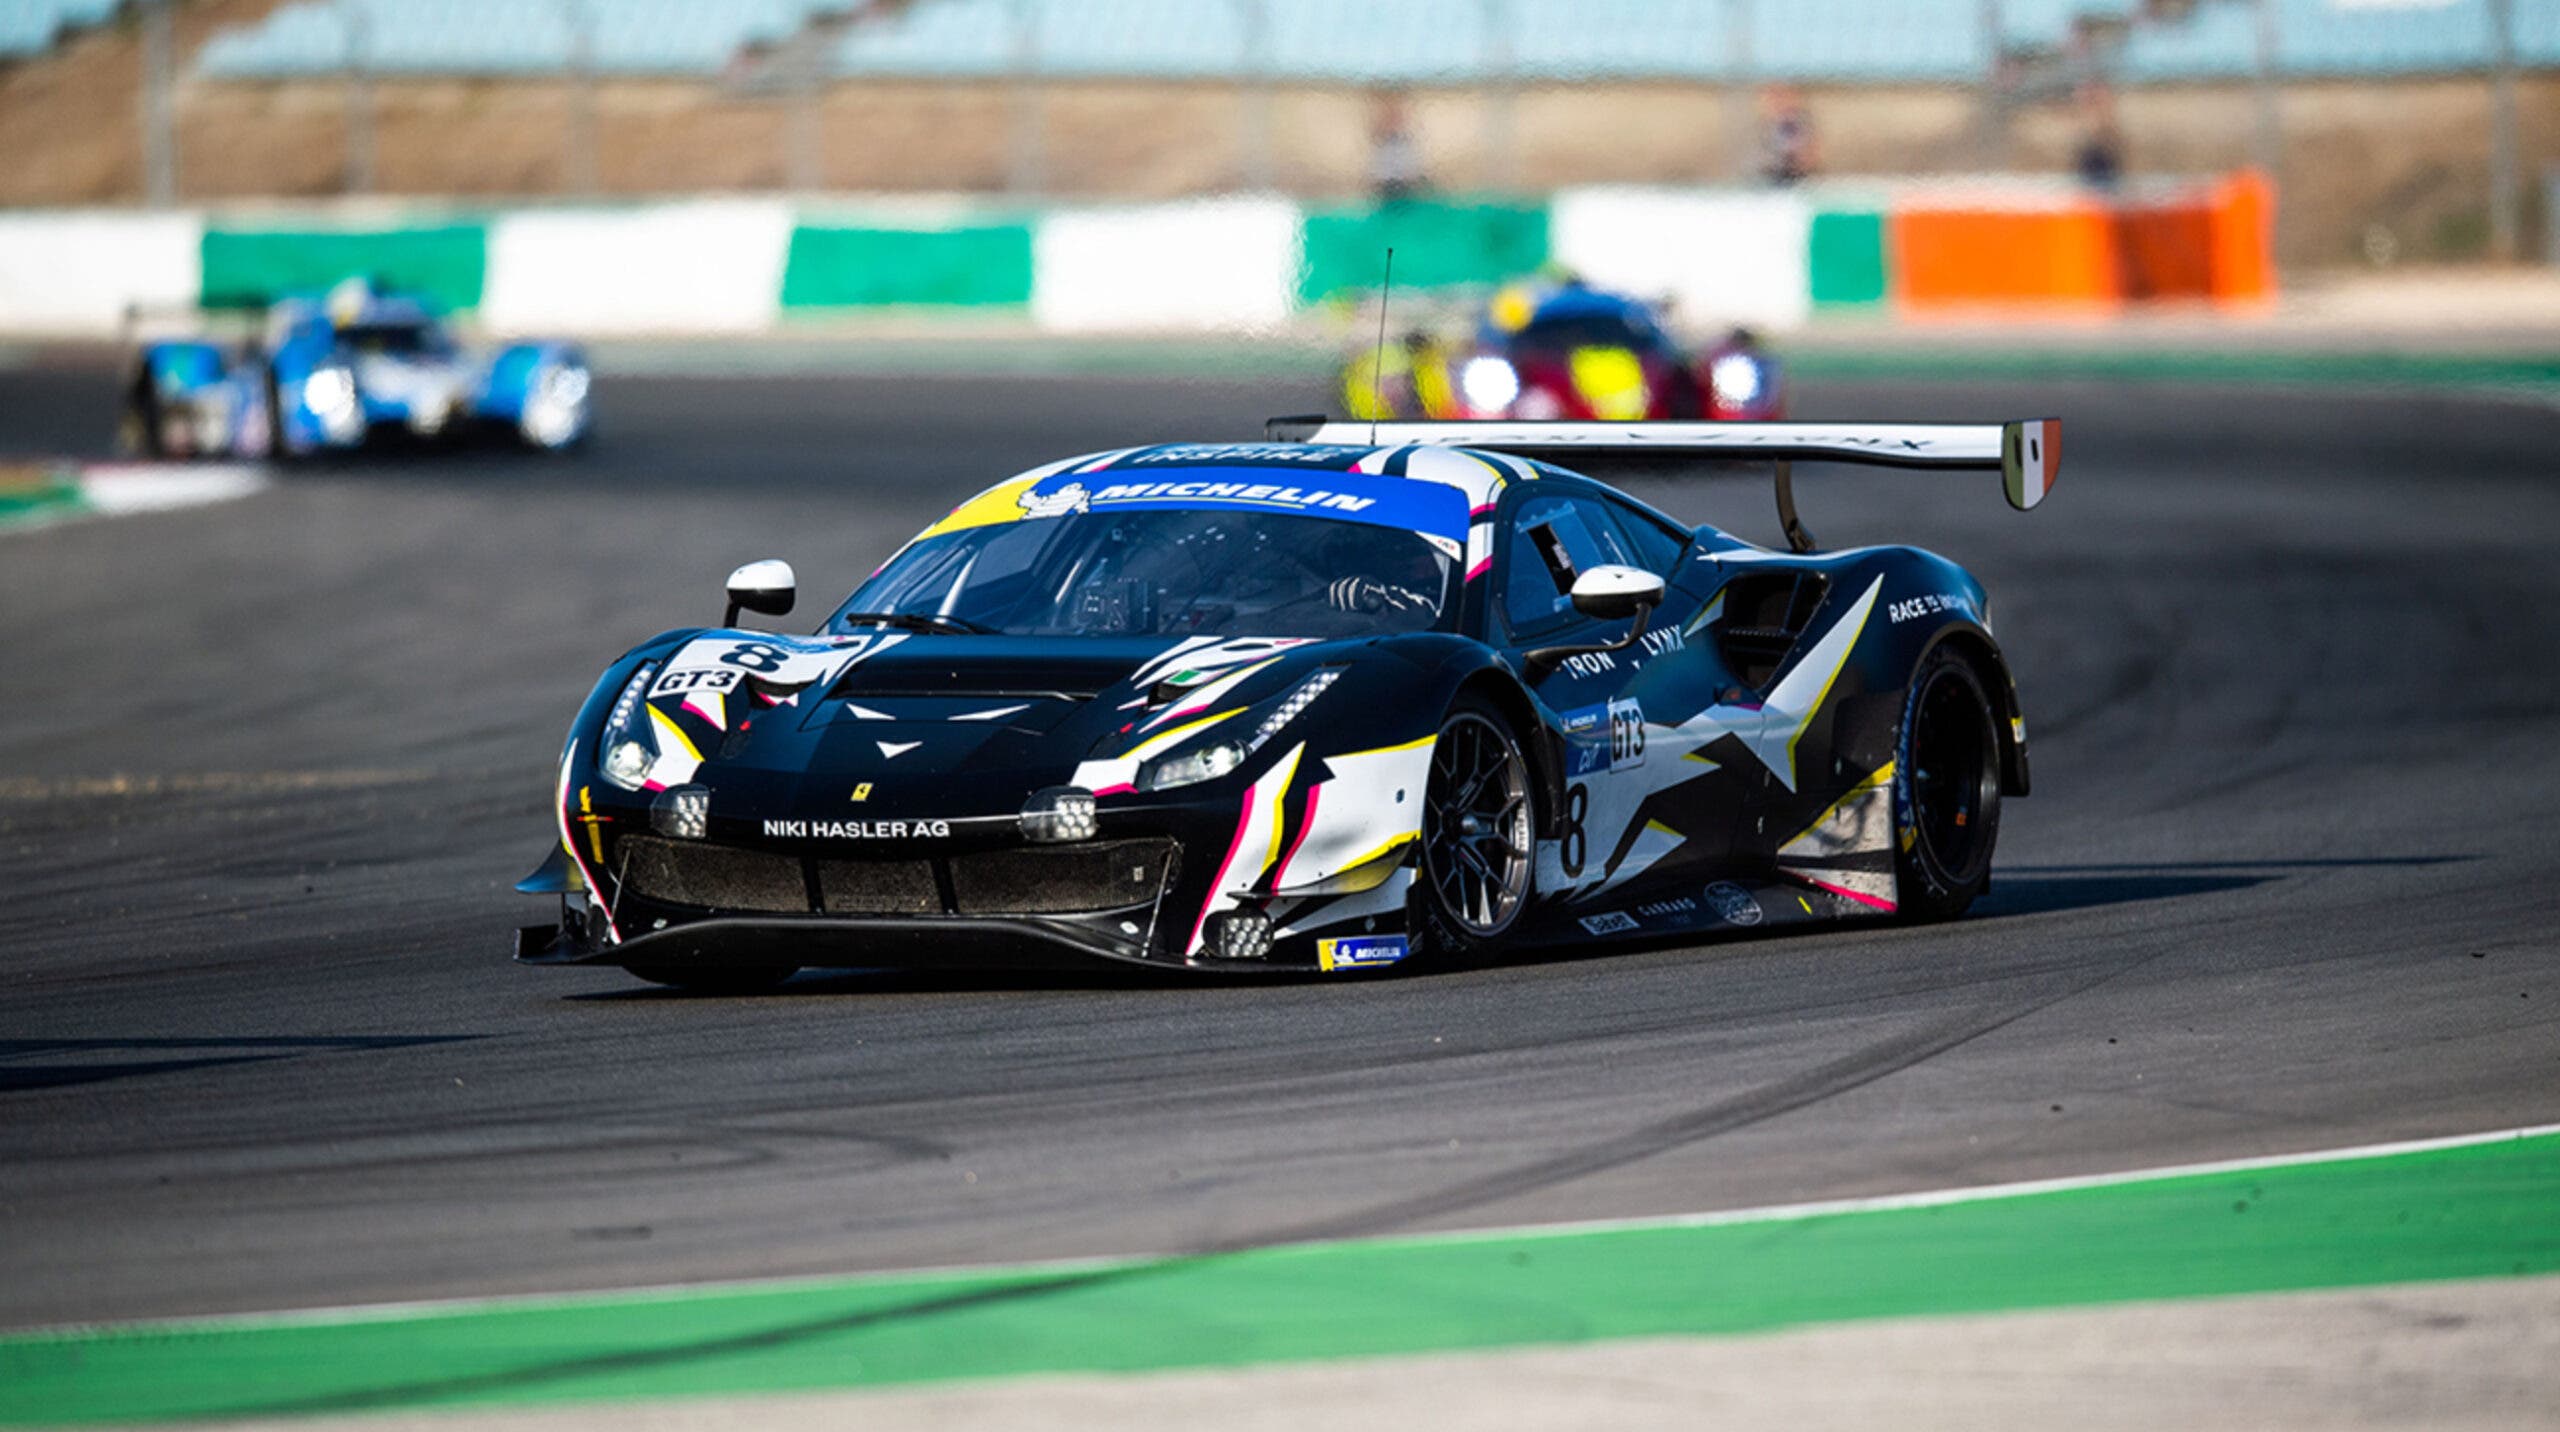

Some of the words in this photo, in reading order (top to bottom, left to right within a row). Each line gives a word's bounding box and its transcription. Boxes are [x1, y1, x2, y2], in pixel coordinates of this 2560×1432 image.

[1091, 482, 1377, 512] MICHELIN
[1888, 597, 1928, 623] RACE
[719, 642, 790, 673] 8
[1561, 651, 1616, 680] IRON
[1640, 624, 1686, 656] LYNX
[657, 669, 736, 687] GT3
[1611, 708, 1646, 762] GT3
[763, 820, 807, 837] NIKI
[812, 820, 908, 838] HASLER
[912, 820, 950, 838] AG
[1560, 782, 1589, 879] 8
